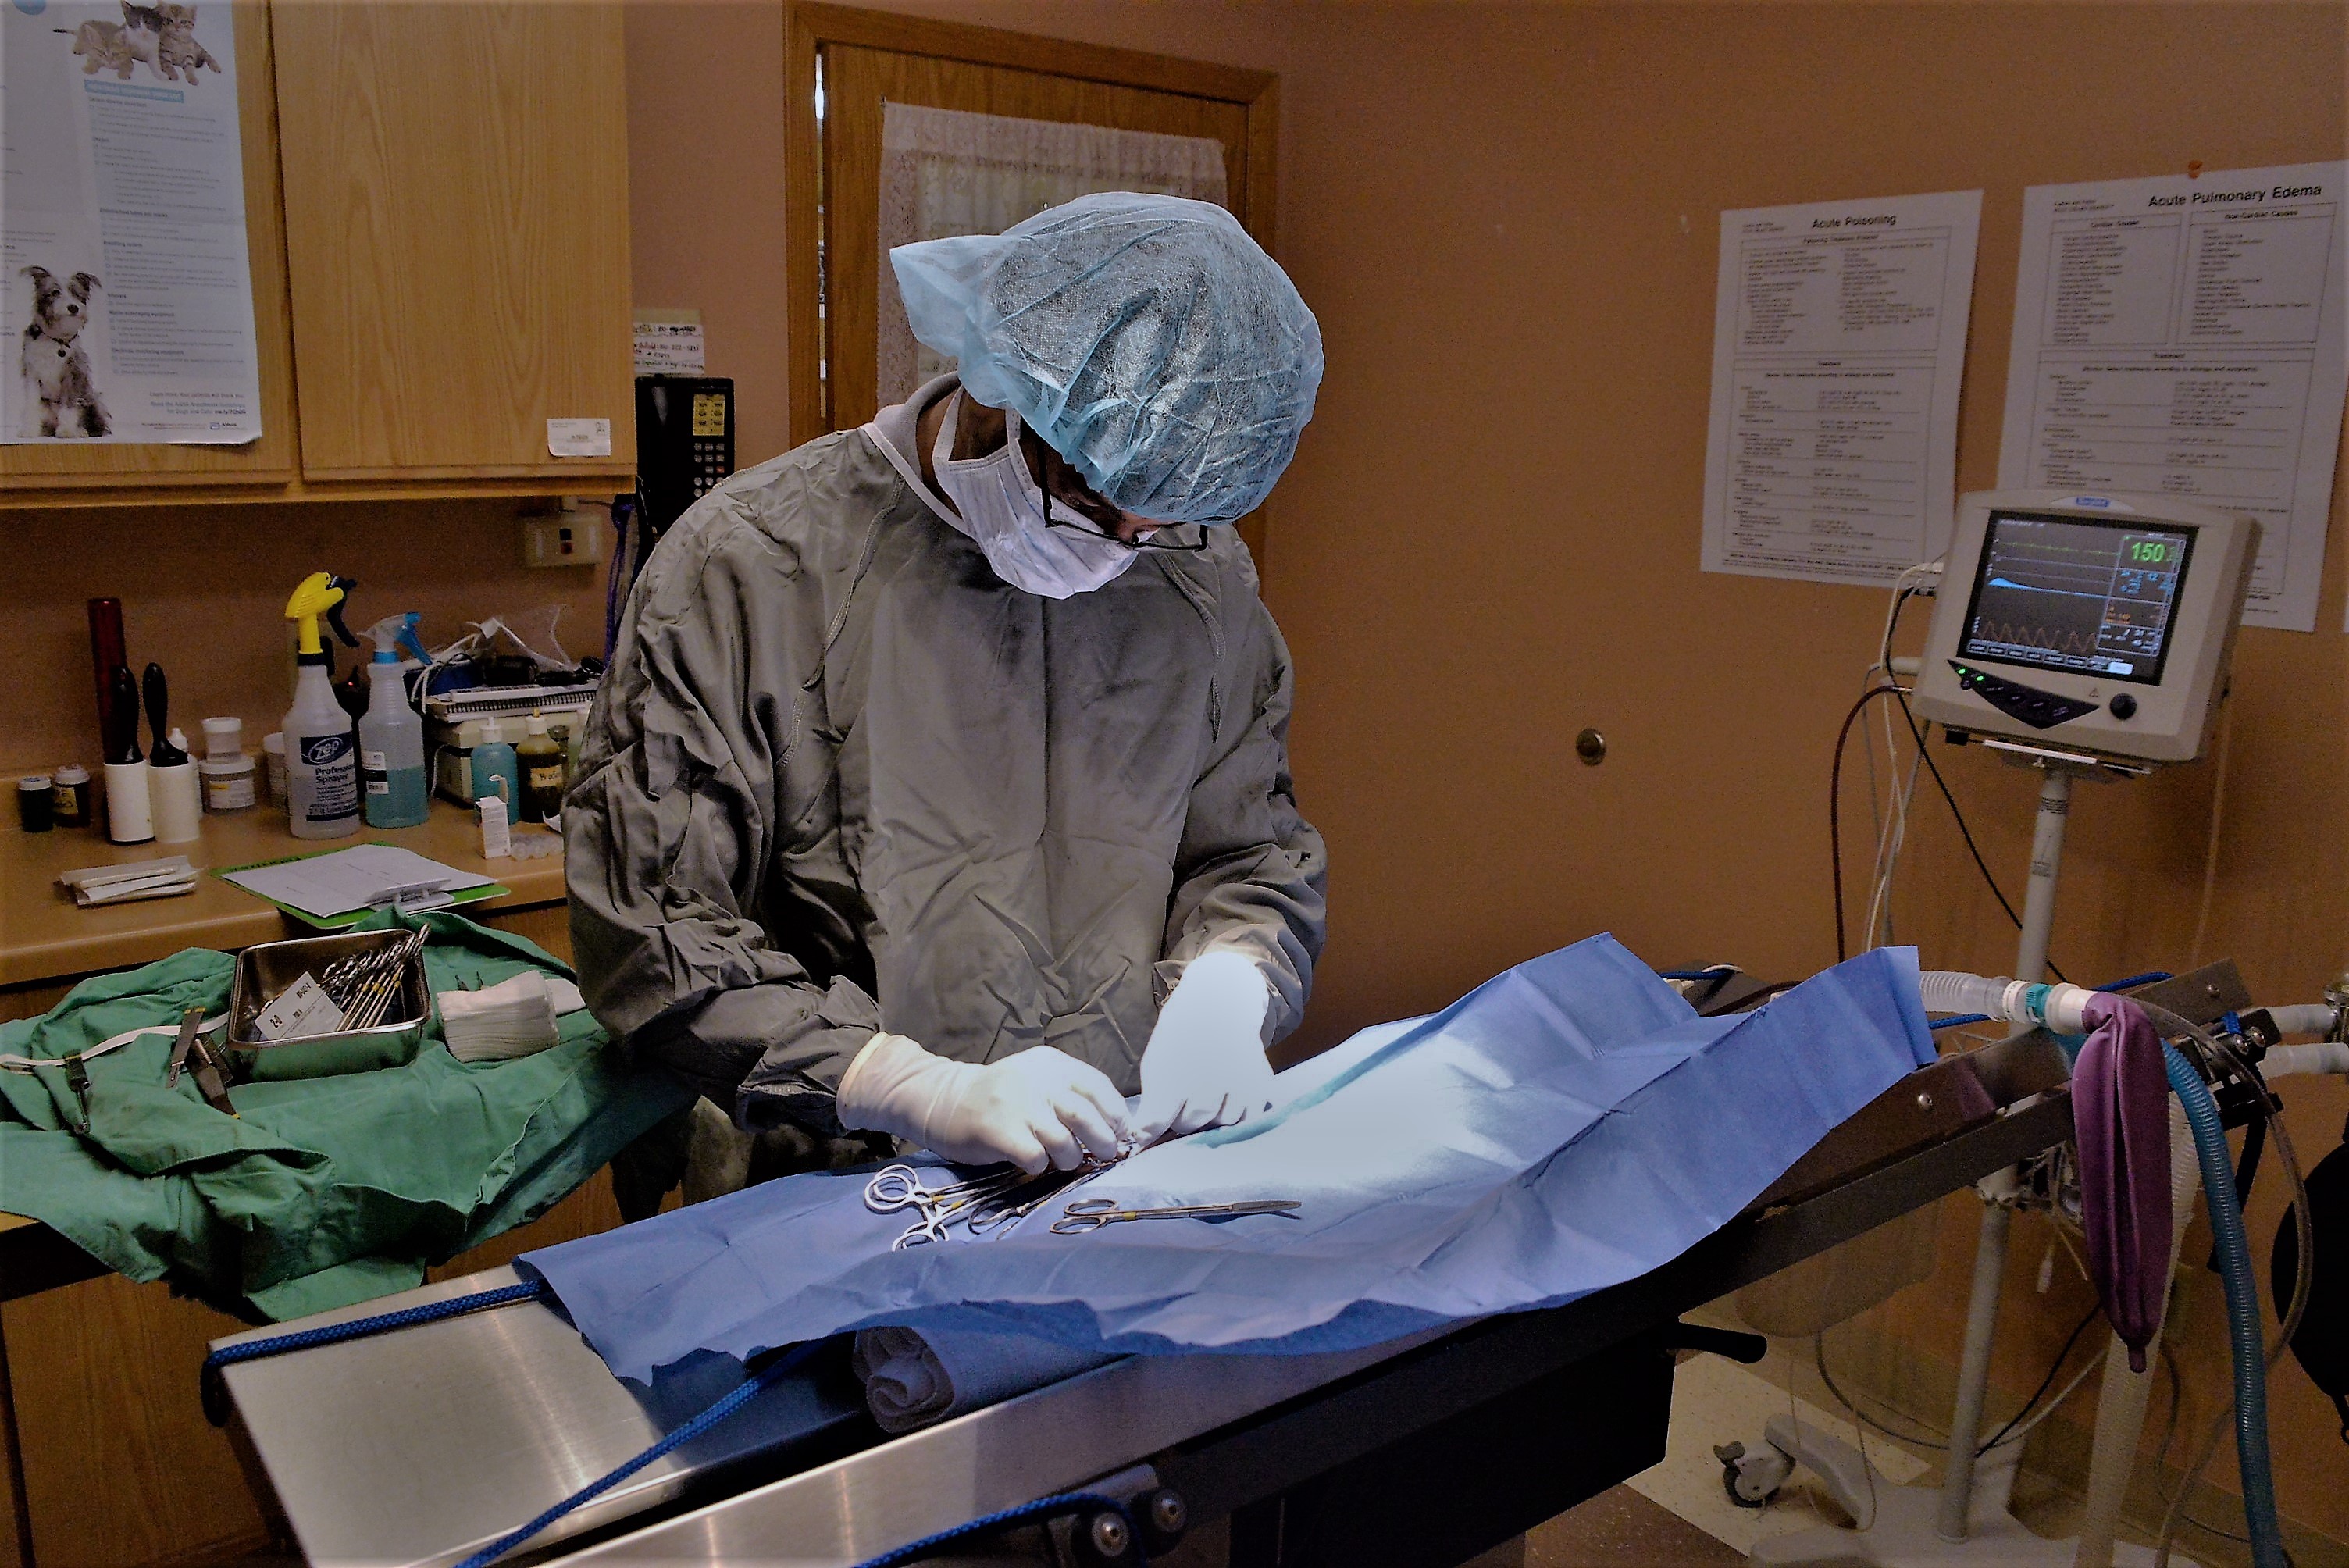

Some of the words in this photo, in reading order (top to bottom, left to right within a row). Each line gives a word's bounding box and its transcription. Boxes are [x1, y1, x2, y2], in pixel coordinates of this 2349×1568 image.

[2148, 193, 2187, 208] Acute
[2192, 187, 2267, 206] Pulmonary
[2272, 183, 2322, 199] Edema
[1812, 217, 1841, 230] Acute
[1845, 213, 1898, 228] Poisoning
[2131, 542, 2166, 562] 150
[315, 740, 340, 760] zep
[315, 764, 355, 775] Professio
[315, 774, 348, 785] Sprayer
[269, 1014, 283, 1029] 2-0
